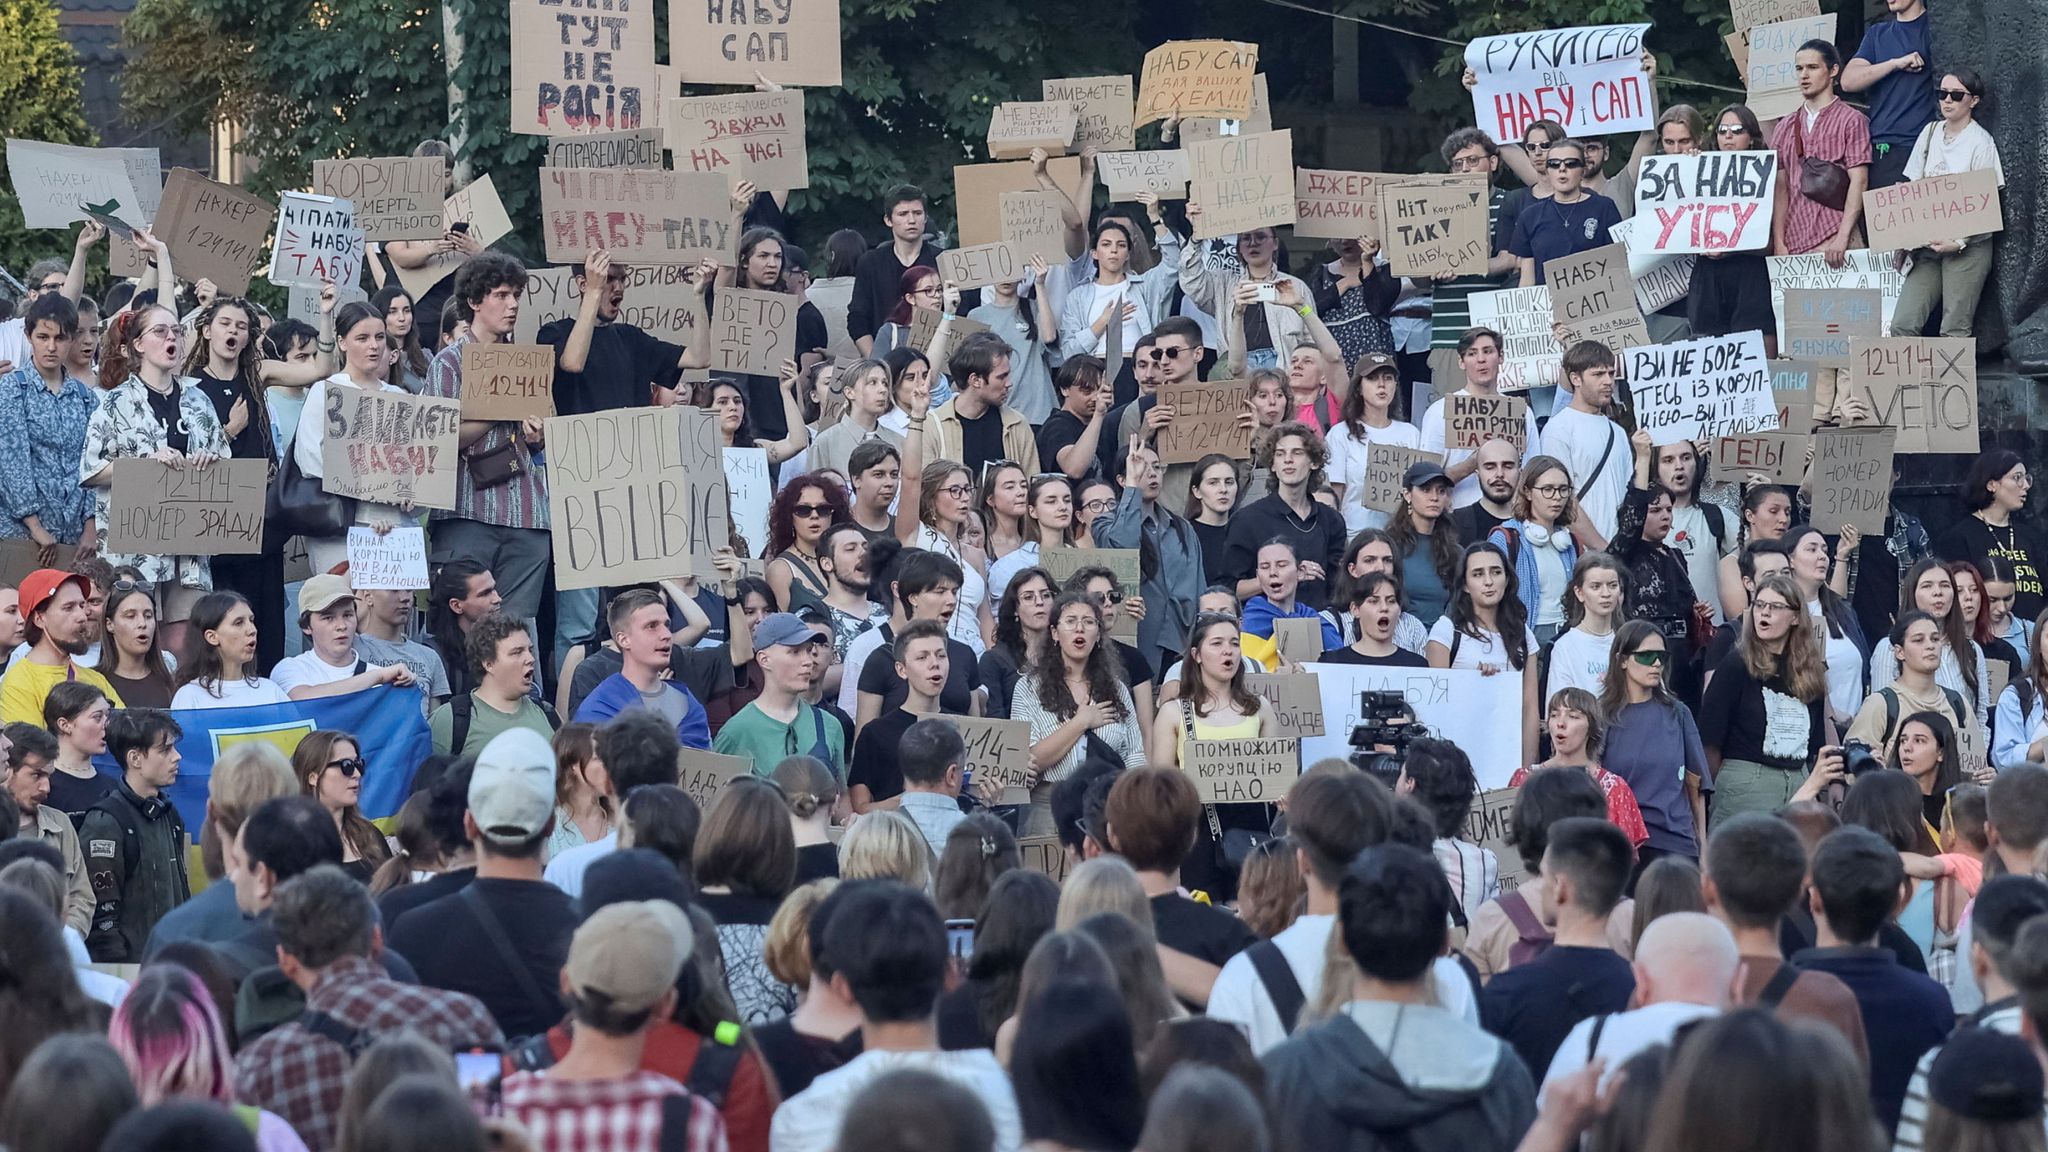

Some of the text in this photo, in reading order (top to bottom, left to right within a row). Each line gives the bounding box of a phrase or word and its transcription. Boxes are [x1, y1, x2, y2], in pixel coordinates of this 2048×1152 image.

[707, 0, 792, 24] НАБУ
[556, 14, 628, 50] ТУТ
[722, 31, 789, 62] САП
[1485, 30, 1583, 74] РУКИ
[563, 52, 614, 83] НЕ
[1150, 50, 1255, 79] НАБУ САП
[1543, 70, 1570, 87] ВІД
[1049, 84, 1127, 101] ЗЛИВАЄТЕ
[1494, 85, 1574, 141] НАБУ
[1592, 76, 1643, 122] САП
[704, 113, 786, 140] ЗАВЖДИ
[690, 148, 730, 171] НА
[322, 161, 443, 198] КОРУПЦІЯ
[1217, 175, 1272, 208] НАБУ
[1641, 154, 1775, 201] ЗА НАБУ
[195, 189, 257, 223] НАХЕР
[354, 198, 417, 214] МЕРТЬ
[1875, 178, 1957, 208] ВЕРНІТЬ
[285, 206, 350, 228] ЧІПАТИ
[360, 214, 441, 232] БУТНЬОГО
[1299, 200, 1363, 218] ВЛАДИ
[1873, 207, 1915, 232] САП
[1933, 193, 1990, 220] НАБУ
[1397, 219, 1450, 246] ТАК!
[1654, 202, 1759, 250] УЇБУ
[311, 232, 353, 254] НАБУ
[1407, 245, 1441, 269] НАБУ
[1447, 240, 1482, 267] САП
[292, 254, 353, 285] ТАБУ
[952, 245, 1012, 280] ВЕТО
[1553, 259, 1608, 290] НАБУ
[722, 295, 786, 329] ВЕТО
[1566, 291, 1610, 319] САП
[720, 325, 752, 345] ДЕ
[1589, 322, 1611, 335] ДЛЯ
[1612, 317, 1641, 330] ВАШИХ
[469, 350, 550, 370] ВЕТУВАТИ
[720, 349, 749, 369] ТИ
[1634, 350, 1666, 381] ВИ
[1671, 349, 1697, 378] НЕ
[1770, 371, 1808, 391] ИПНЯ
[1164, 388, 1249, 417] ВЕТУВАТИ
[1454, 397, 1501, 417] НАБУ
[1633, 382, 1682, 410] ТЕСЬ
[1864, 381, 1972, 431] VETO
[327, 387, 459, 446] ЗЛИВАЄТЕ
[1453, 415, 1527, 436] САП РЯТУЙ
[551, 413, 718, 485] КОРУПЦІЯ
[1823, 436, 1863, 461] 12414
[1369, 470, 1399, 483] НОМ
[1825, 459, 1881, 482] НОМЕР
[158, 468, 232, 503] 12414
[1825, 487, 1886, 514] ЗРАДИ
[120, 506, 186, 541] НОМЕР
[195, 508, 262, 545] ЗРАДИ
[565, 481, 722, 571] ВБИВАЄ
[349, 533, 362, 547] ВИ
[365, 535, 385, 547] НАМ
[352, 561, 403, 575] МИ ВАМ
[353, 548, 421, 562] КОРУПЦІЮ
[1195, 739, 1296, 758] ПОМНОЖИТИ
[1213, 778, 1263, 801] НАО
